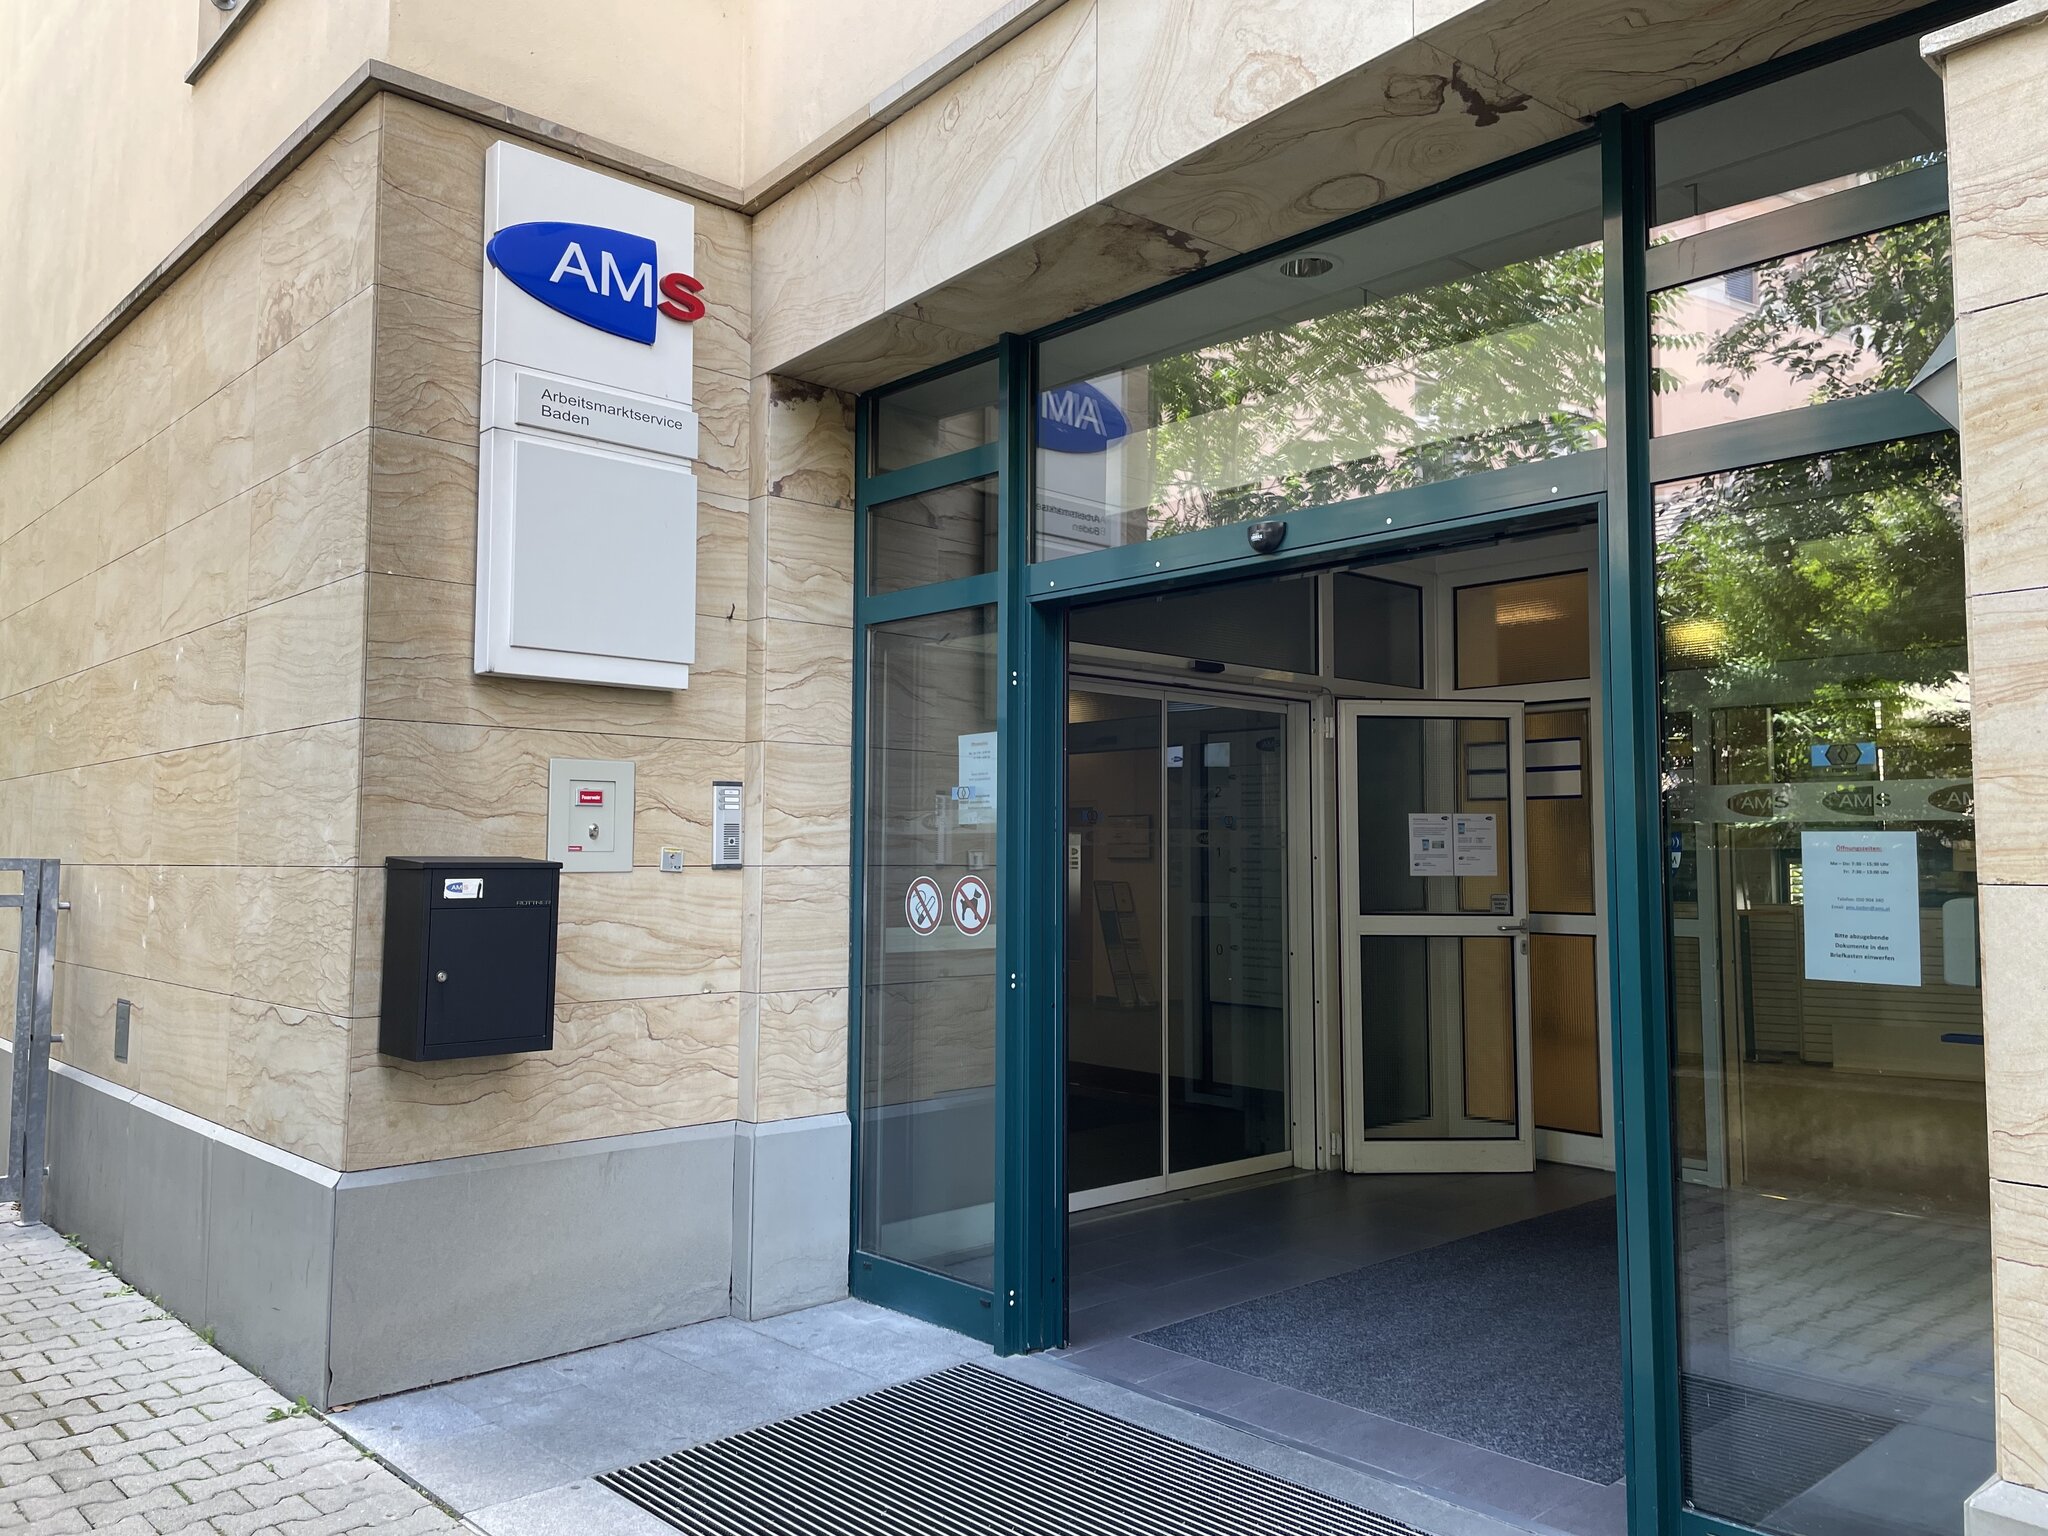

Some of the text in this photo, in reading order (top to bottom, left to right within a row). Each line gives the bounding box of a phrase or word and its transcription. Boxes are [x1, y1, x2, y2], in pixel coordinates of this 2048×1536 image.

[549, 241, 706, 323] AMS
[541, 388, 683, 431] Arbeitsmarktservice
[541, 404, 590, 427] Baden
[1741, 795, 1789, 809] AMS
[1838, 792, 1892, 808] AMS
[1849, 933, 1889, 941] abzugebende
[1834, 942, 1869, 950] Dokumente
[1829, 952, 1863, 960] Briefkasten
